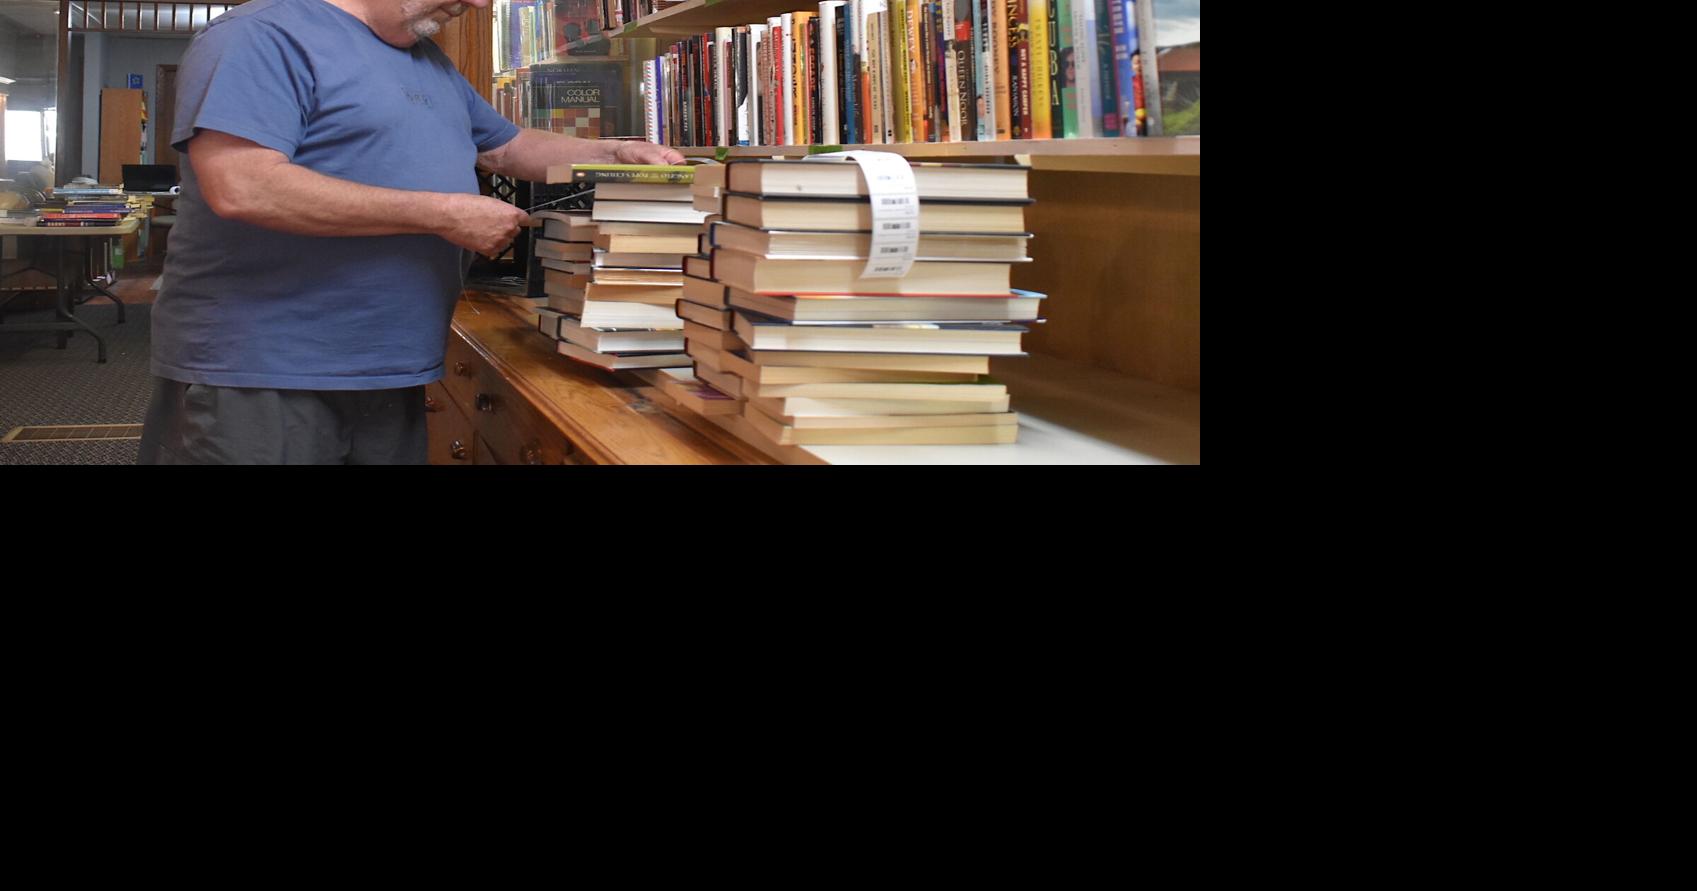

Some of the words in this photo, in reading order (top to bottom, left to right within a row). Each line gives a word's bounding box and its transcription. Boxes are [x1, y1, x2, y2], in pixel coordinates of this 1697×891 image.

[906, 9, 917, 53] DEWEY
[957, 50, 966, 88] QUEEN
[959, 91, 969, 125] NOOR
